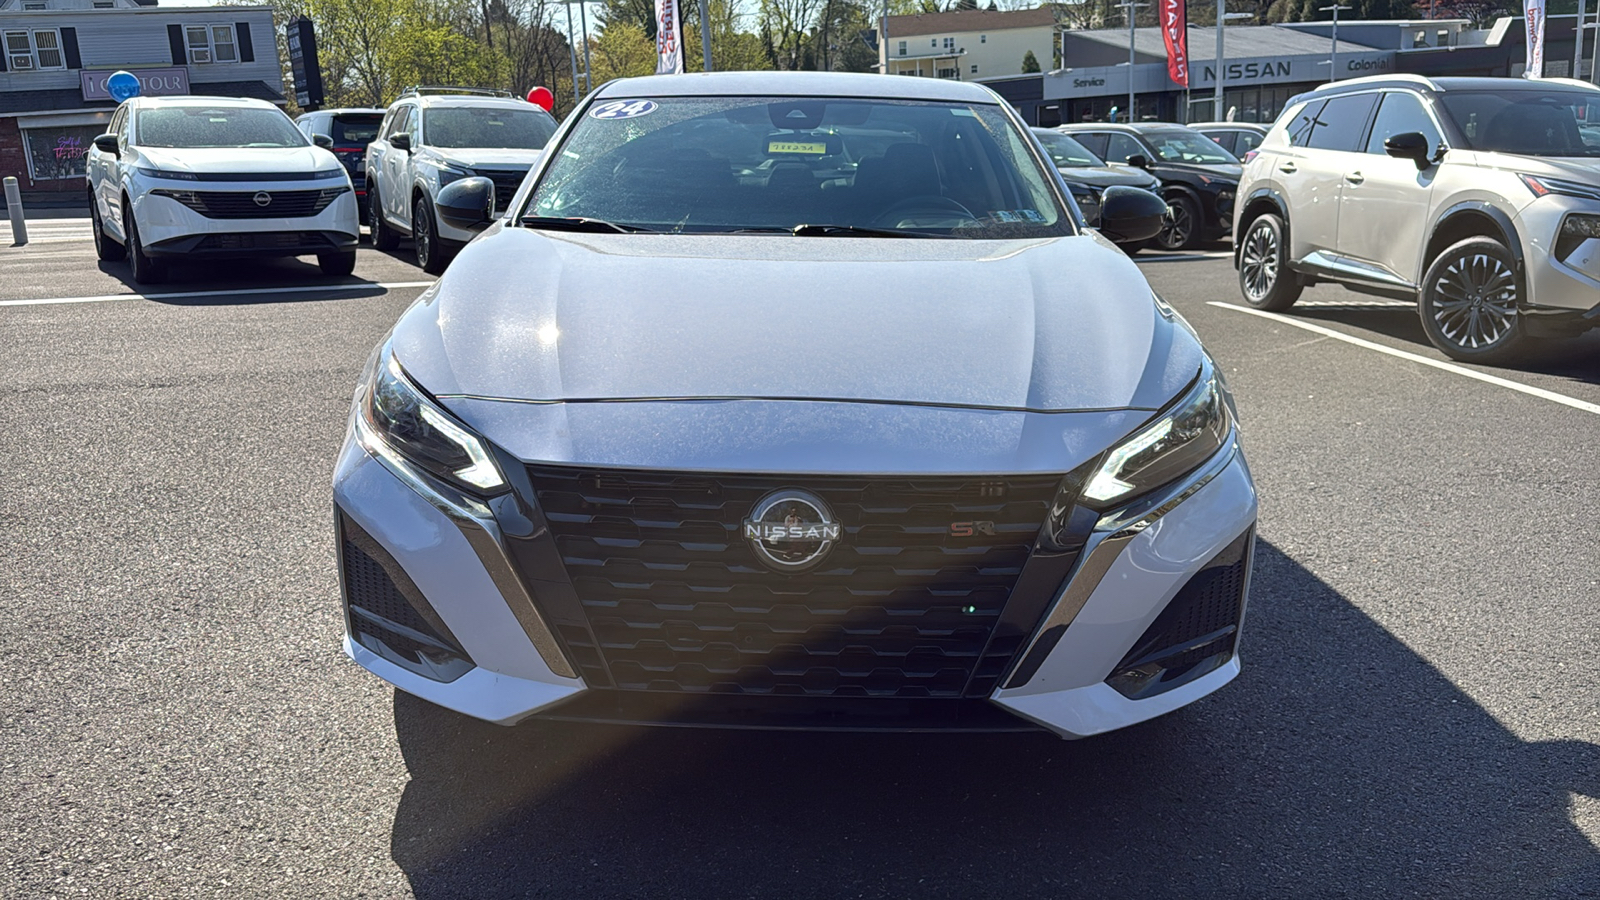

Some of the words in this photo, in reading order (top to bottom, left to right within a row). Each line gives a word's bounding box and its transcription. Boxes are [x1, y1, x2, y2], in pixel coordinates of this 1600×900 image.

[1203, 61, 1291, 81] NISSAN
[1347, 57, 1390, 71] Colonial
[1073, 77, 1105, 88] Service
[597, 100, 649, 118] 24
[746, 524, 839, 538] NISSAN
[951, 521, 996, 536] SR
